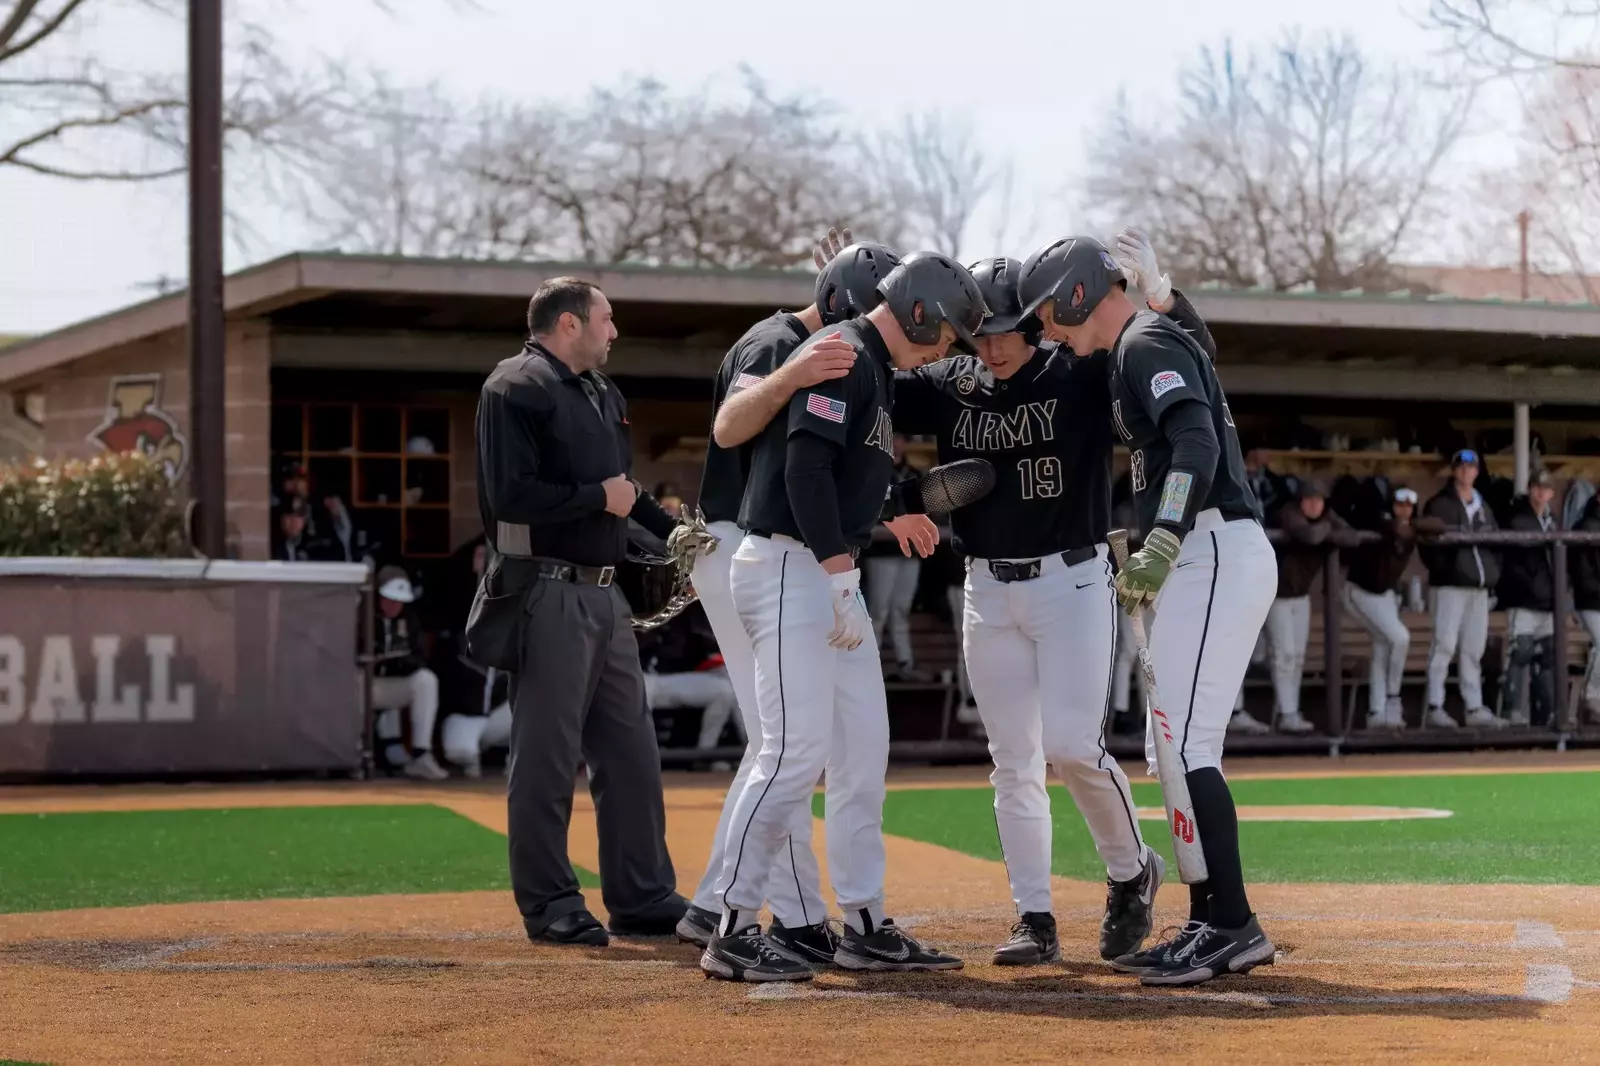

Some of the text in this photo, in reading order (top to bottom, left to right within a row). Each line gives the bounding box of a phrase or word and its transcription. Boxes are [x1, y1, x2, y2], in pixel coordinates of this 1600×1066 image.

[960, 378, 973, 391] 20
[952, 399, 1057, 450] ARMY
[1017, 456, 1062, 499] 19
